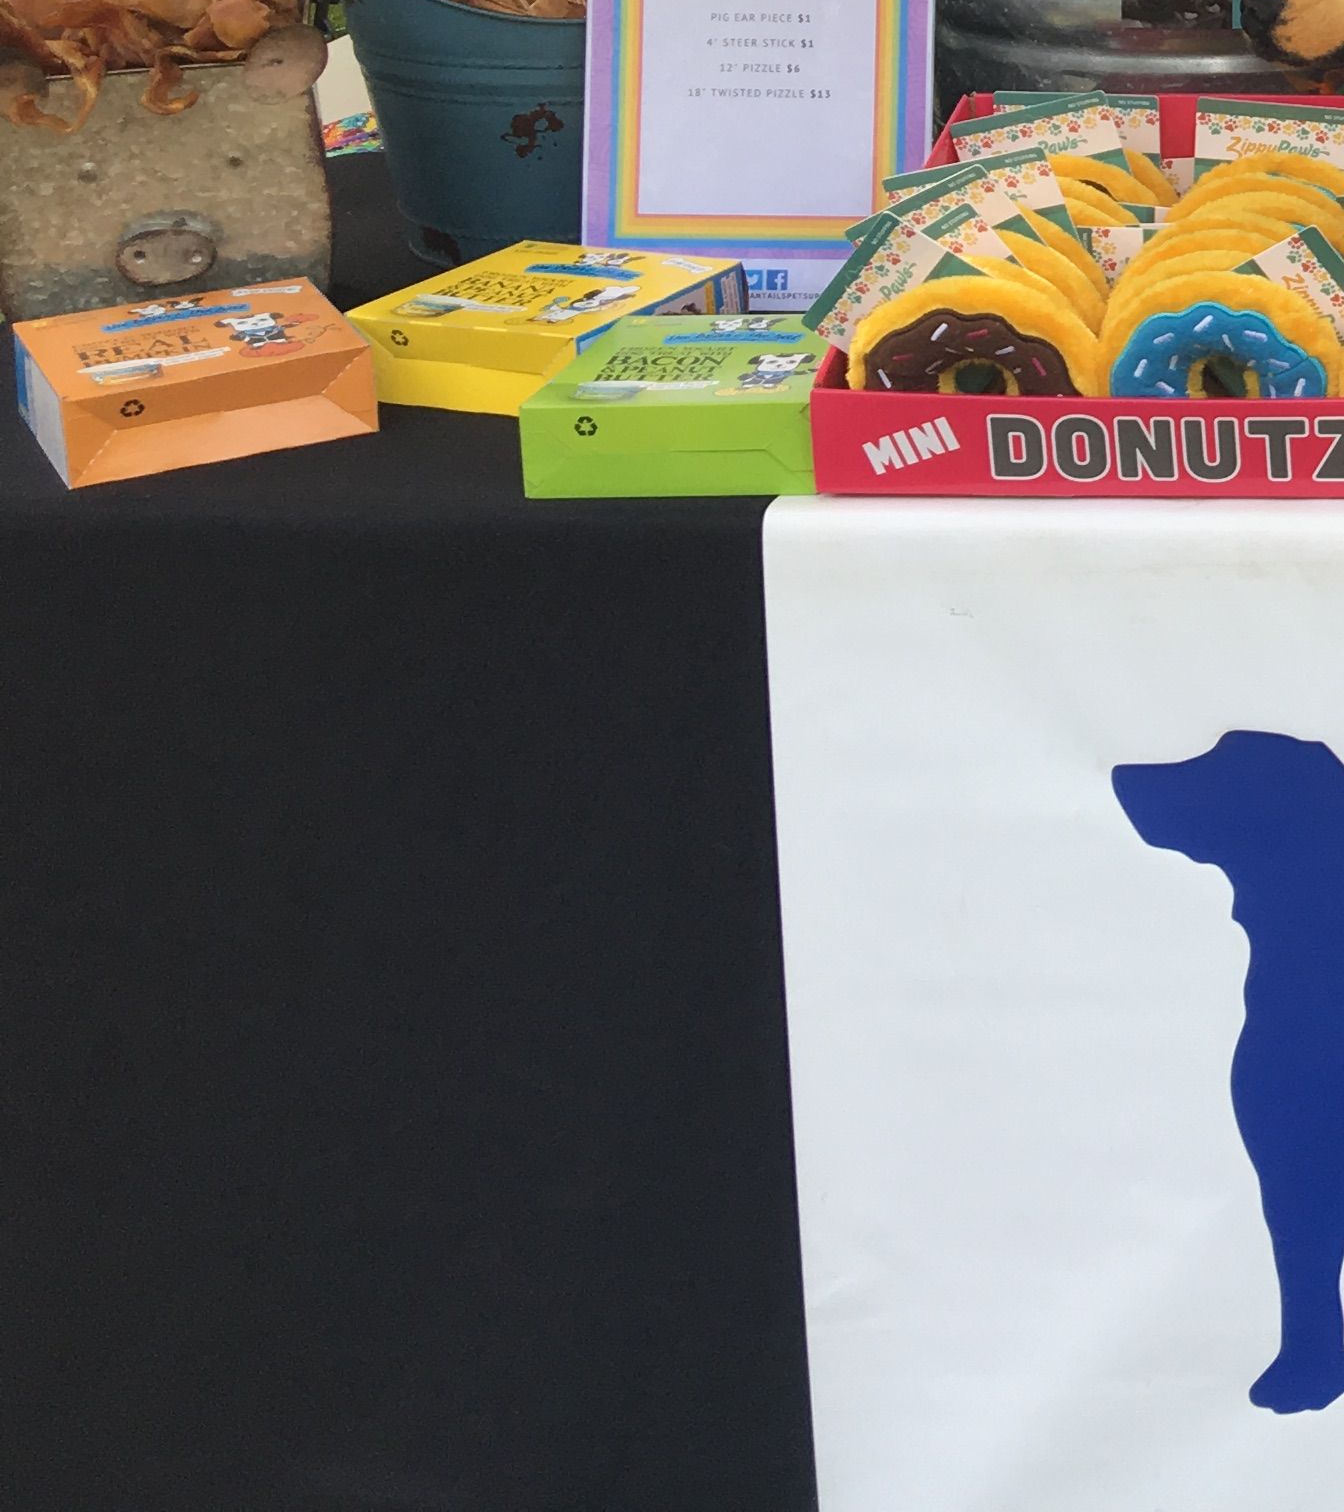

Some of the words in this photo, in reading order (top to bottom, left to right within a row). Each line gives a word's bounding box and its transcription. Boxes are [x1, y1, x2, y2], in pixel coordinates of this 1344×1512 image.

[710, 12, 730, 23] PIG
[734, 13, 757, 23] EAR
[760, 13, 793, 24] PIECE
[797, 13, 812, 24] $1
[721, 38, 758, 48] STEER
[762, 39, 796, 49] STICK
[800, 39, 815, 49] $1
[742, 63, 782, 74] PIZZLE
[786, 63, 801, 74] $6
[710, 88, 762, 99] TWISTED
[766, 89, 805, 99] PIZZLE
[809, 89, 832, 100] $13
[606, 355, 729, 366] BACON
[862, 416, 961, 475] MINI
